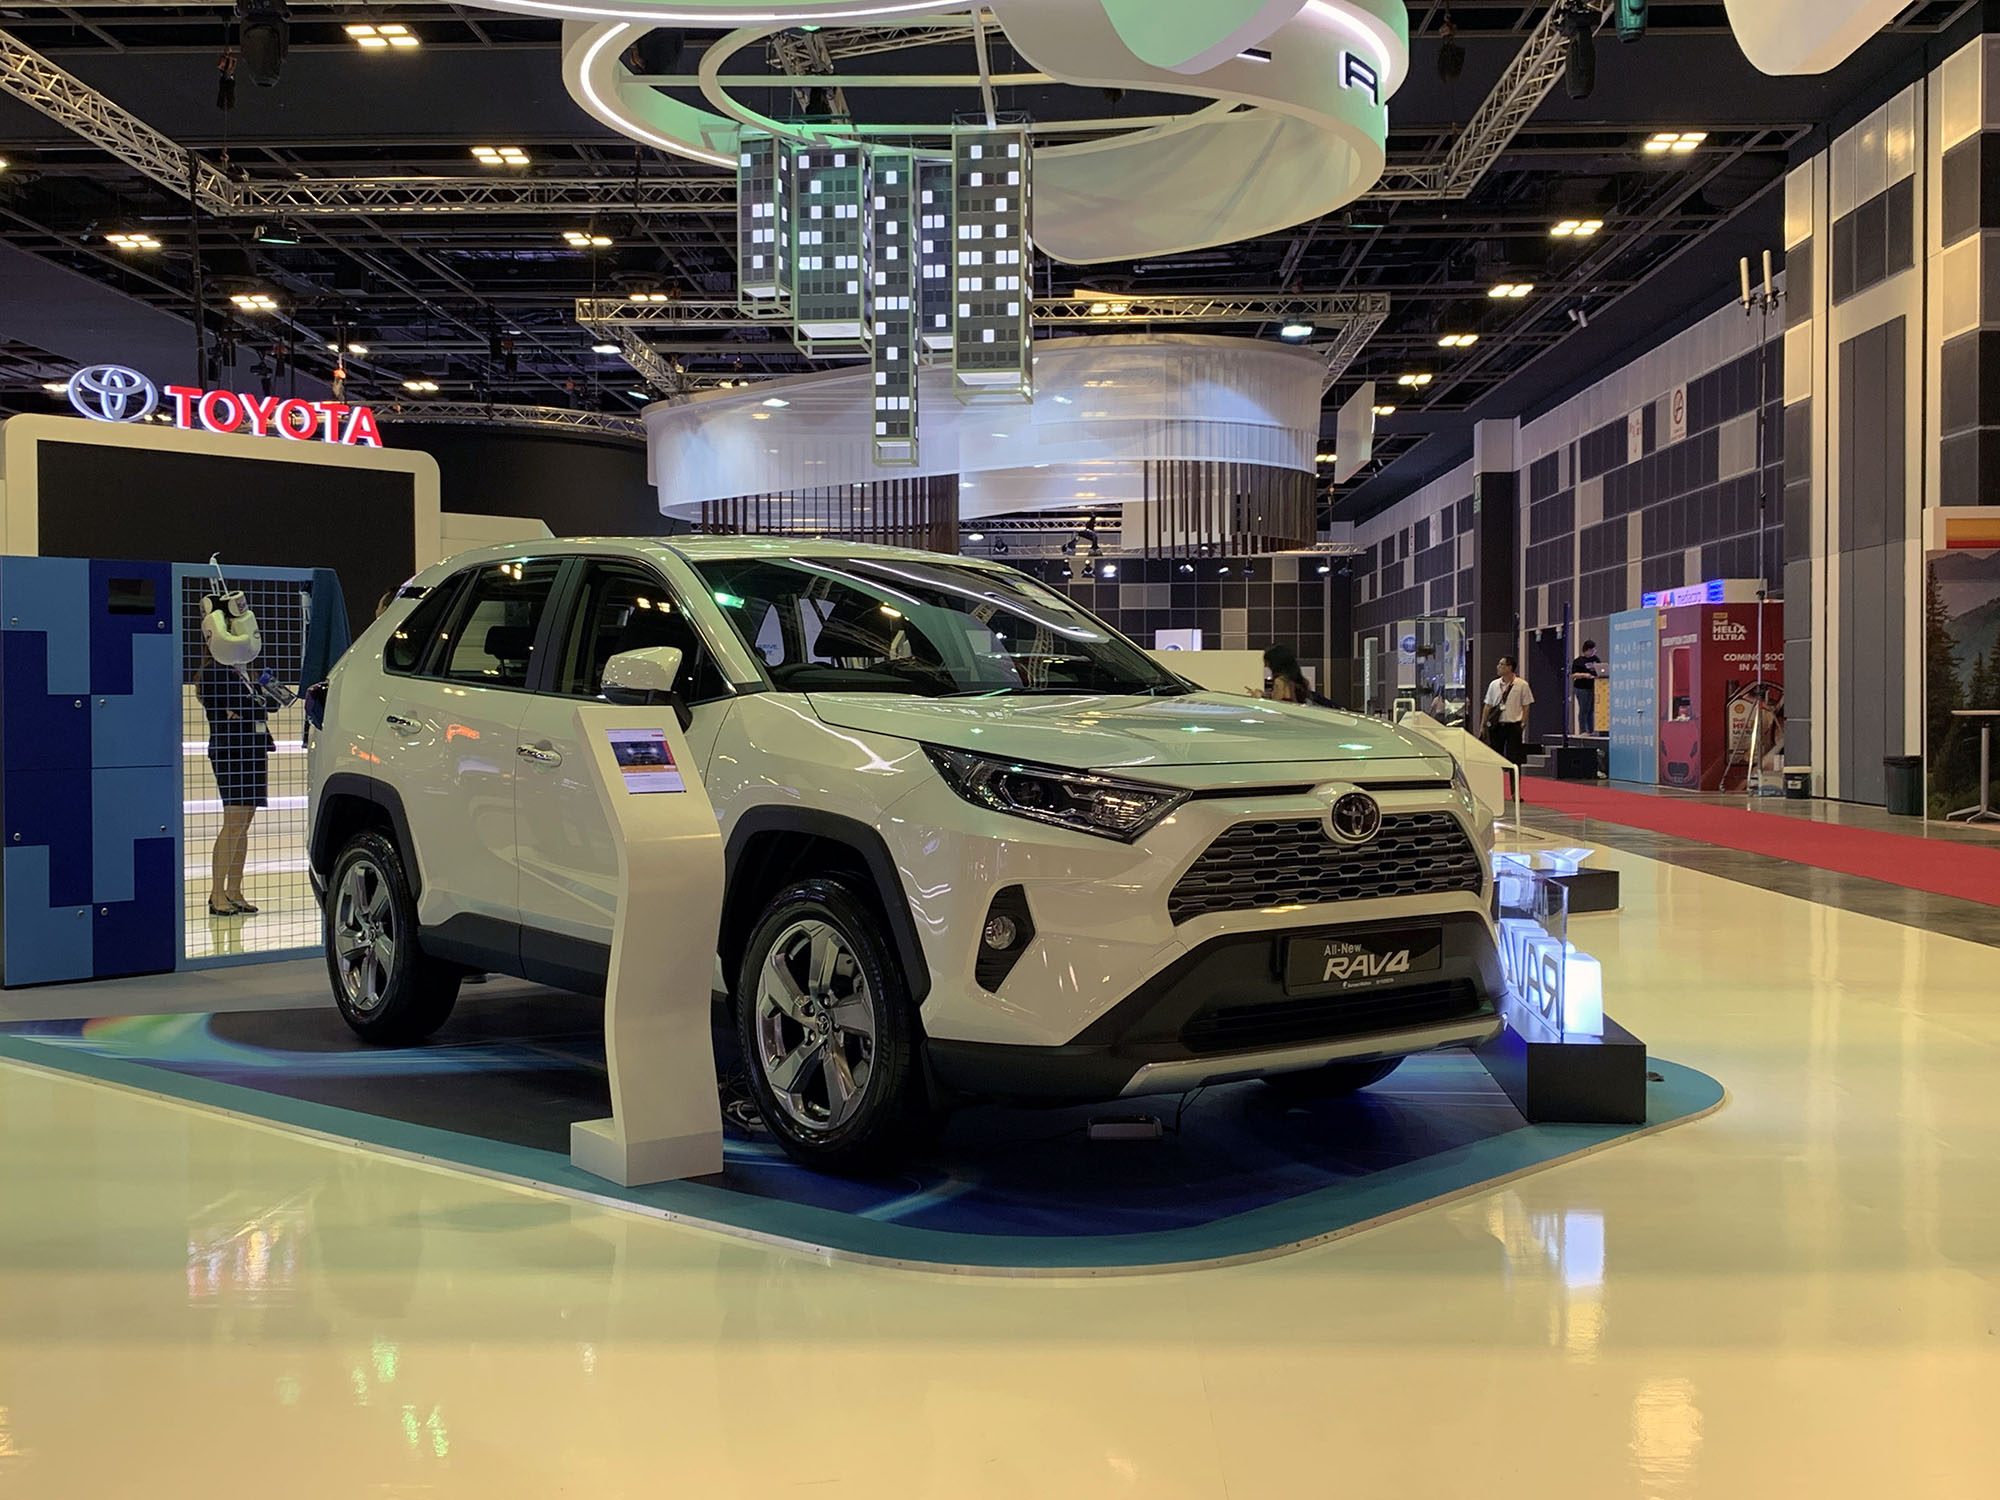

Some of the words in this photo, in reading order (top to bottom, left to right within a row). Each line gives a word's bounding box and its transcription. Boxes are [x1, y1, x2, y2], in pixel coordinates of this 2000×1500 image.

[164, 385, 383, 448] TOYOTA
[1712, 623, 1748, 634] HELIX
[1712, 633, 1746, 641] ULTRA
[1764, 653, 1785, 661] SOO
[1738, 663, 1750, 671] IN
[1323, 943, 1362, 956] All-New
[1322, 949, 1410, 981] RAV4
